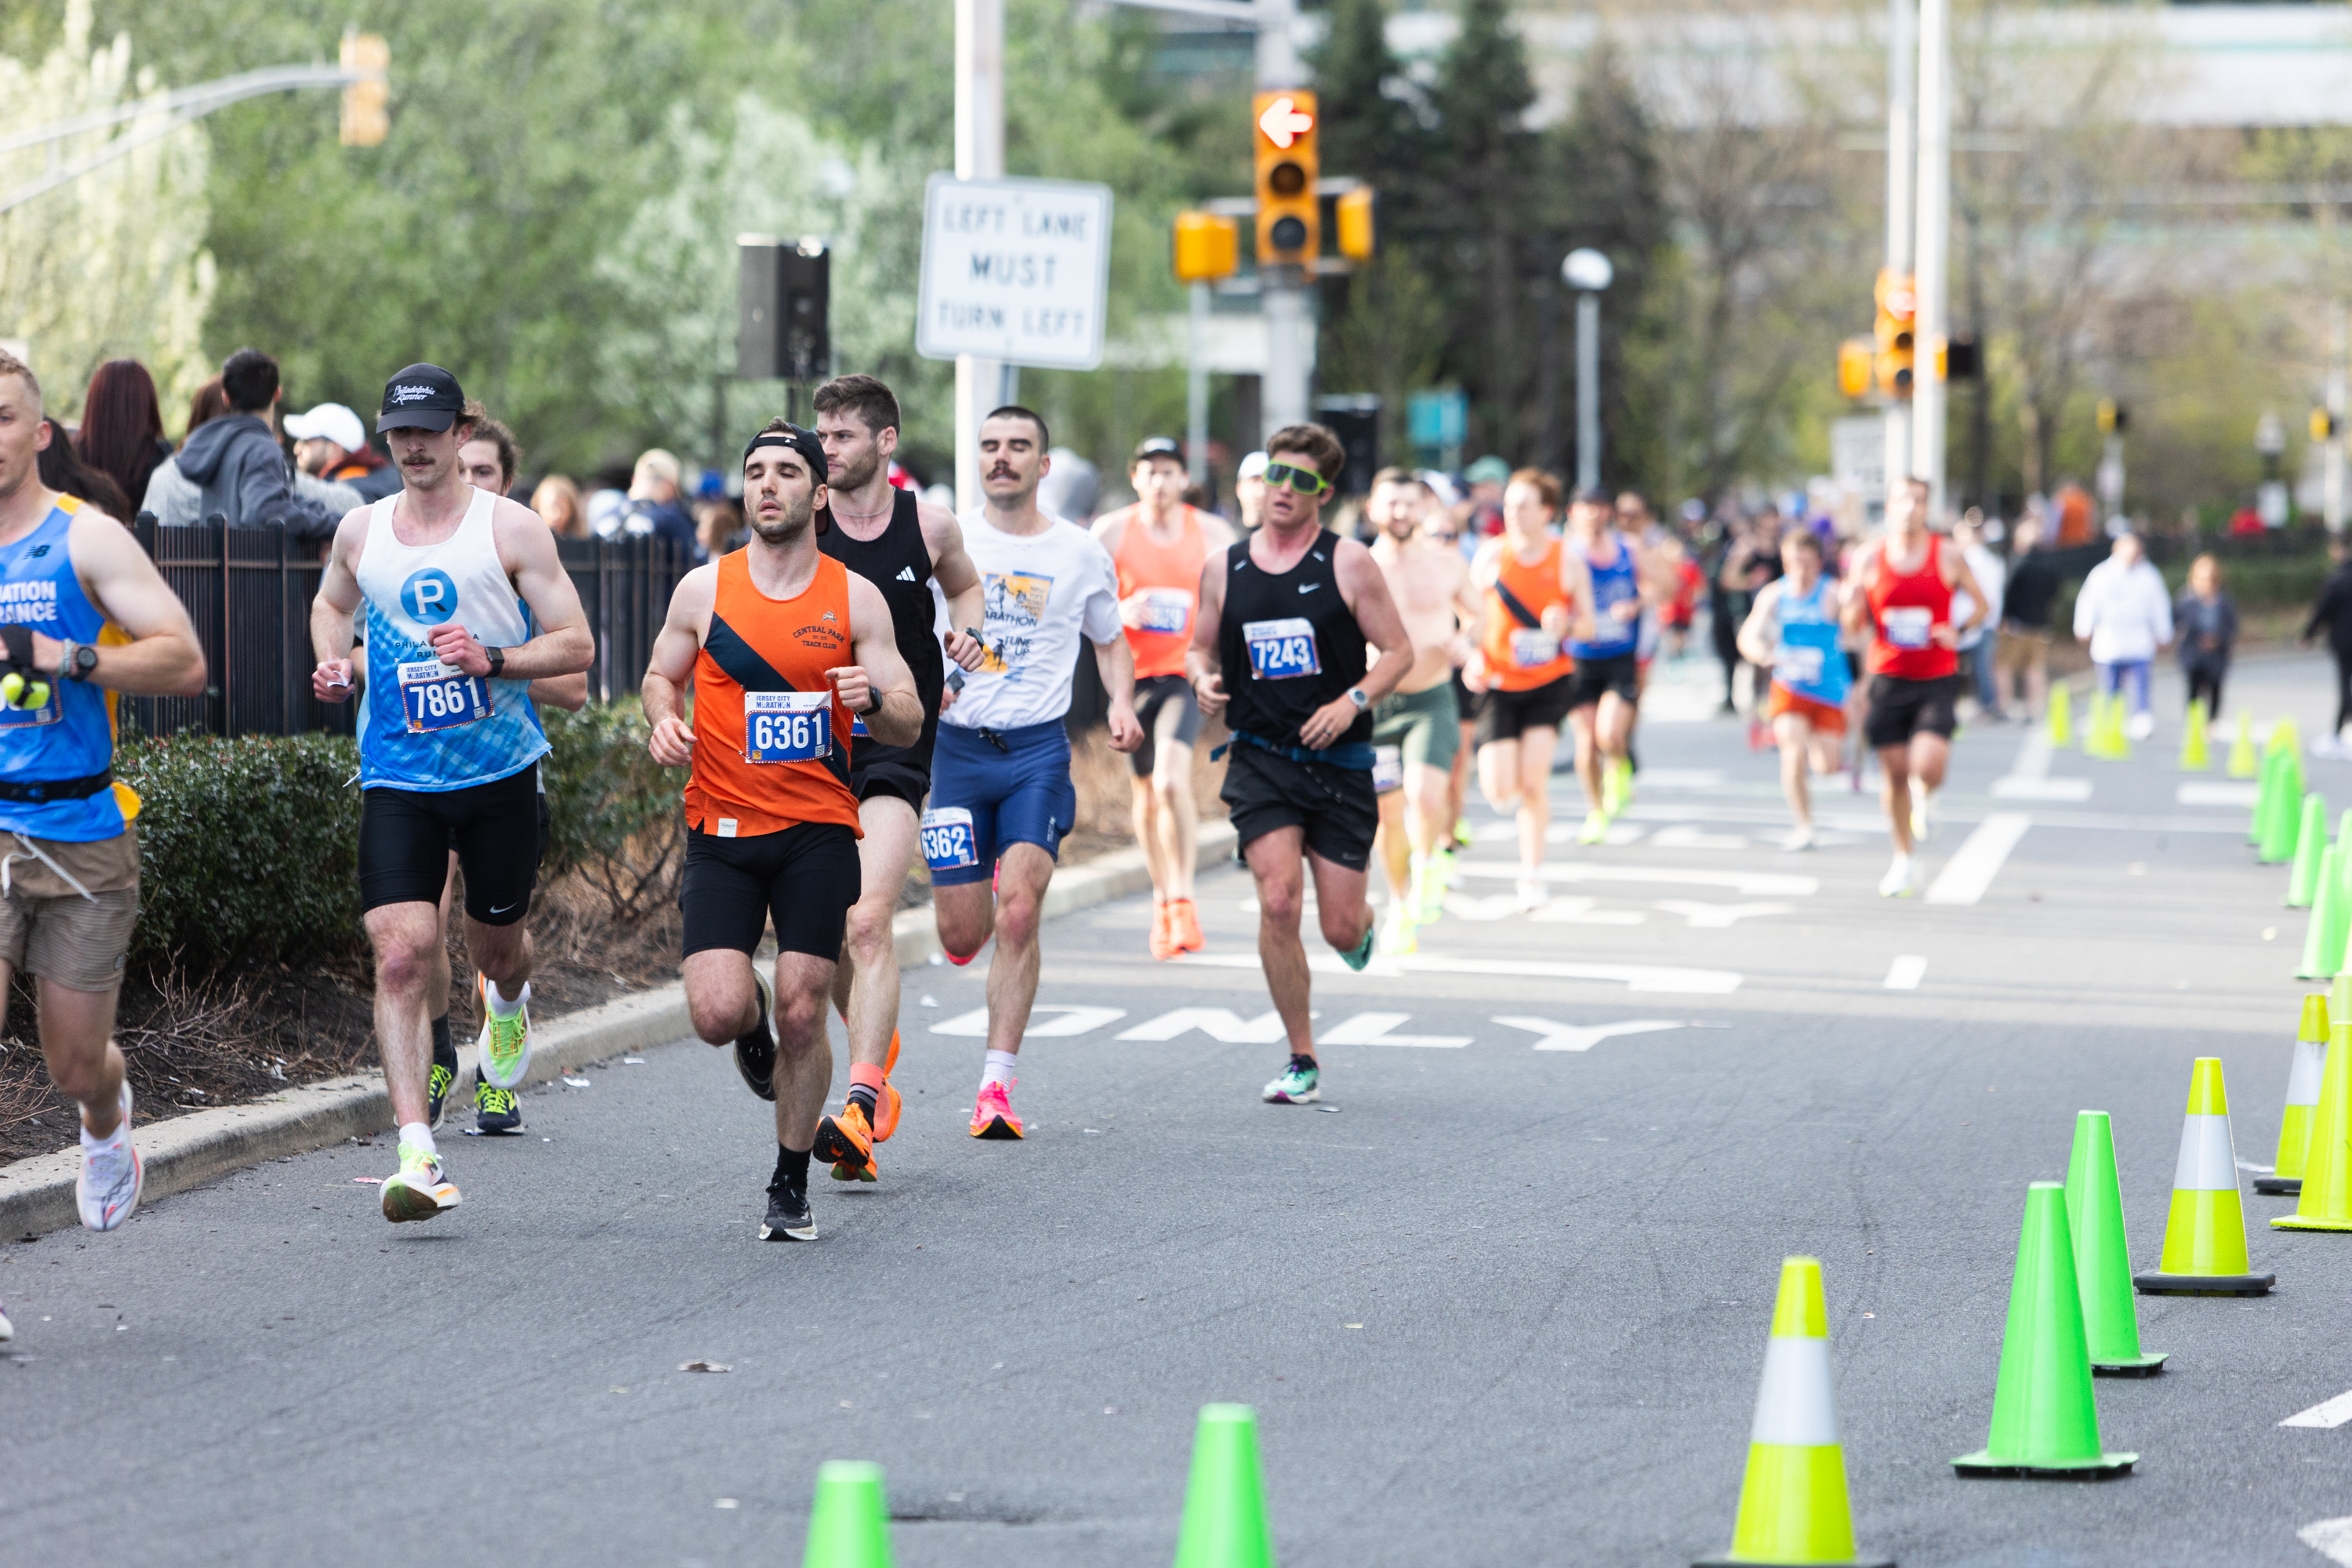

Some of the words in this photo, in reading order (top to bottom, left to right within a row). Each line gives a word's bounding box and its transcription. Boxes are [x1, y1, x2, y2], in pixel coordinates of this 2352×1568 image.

[943, 204, 1004, 233] LEFT
[1022, 209, 1088, 241] LANE
[971, 252, 1057, 287] MUST
[938, 299, 1004, 329] TURN
[1022, 307, 1084, 337] LEFT
[390, 394, 428, 405] Runner
[392, 384, 436, 397] Philadelphia
[0, 580, 57, 603] ATION
[793, 626, 826, 639] CENTRAL
[827, 628, 845, 644] PARK
[1014, 646, 1030, 657] UP
[1252, 637, 1311, 670] 7243
[408, 676, 481, 720] 7861
[755, 712, 823, 750] 6361
[920, 826, 968, 861] 6362
[928, 1004, 1689, 1052] ONLY
